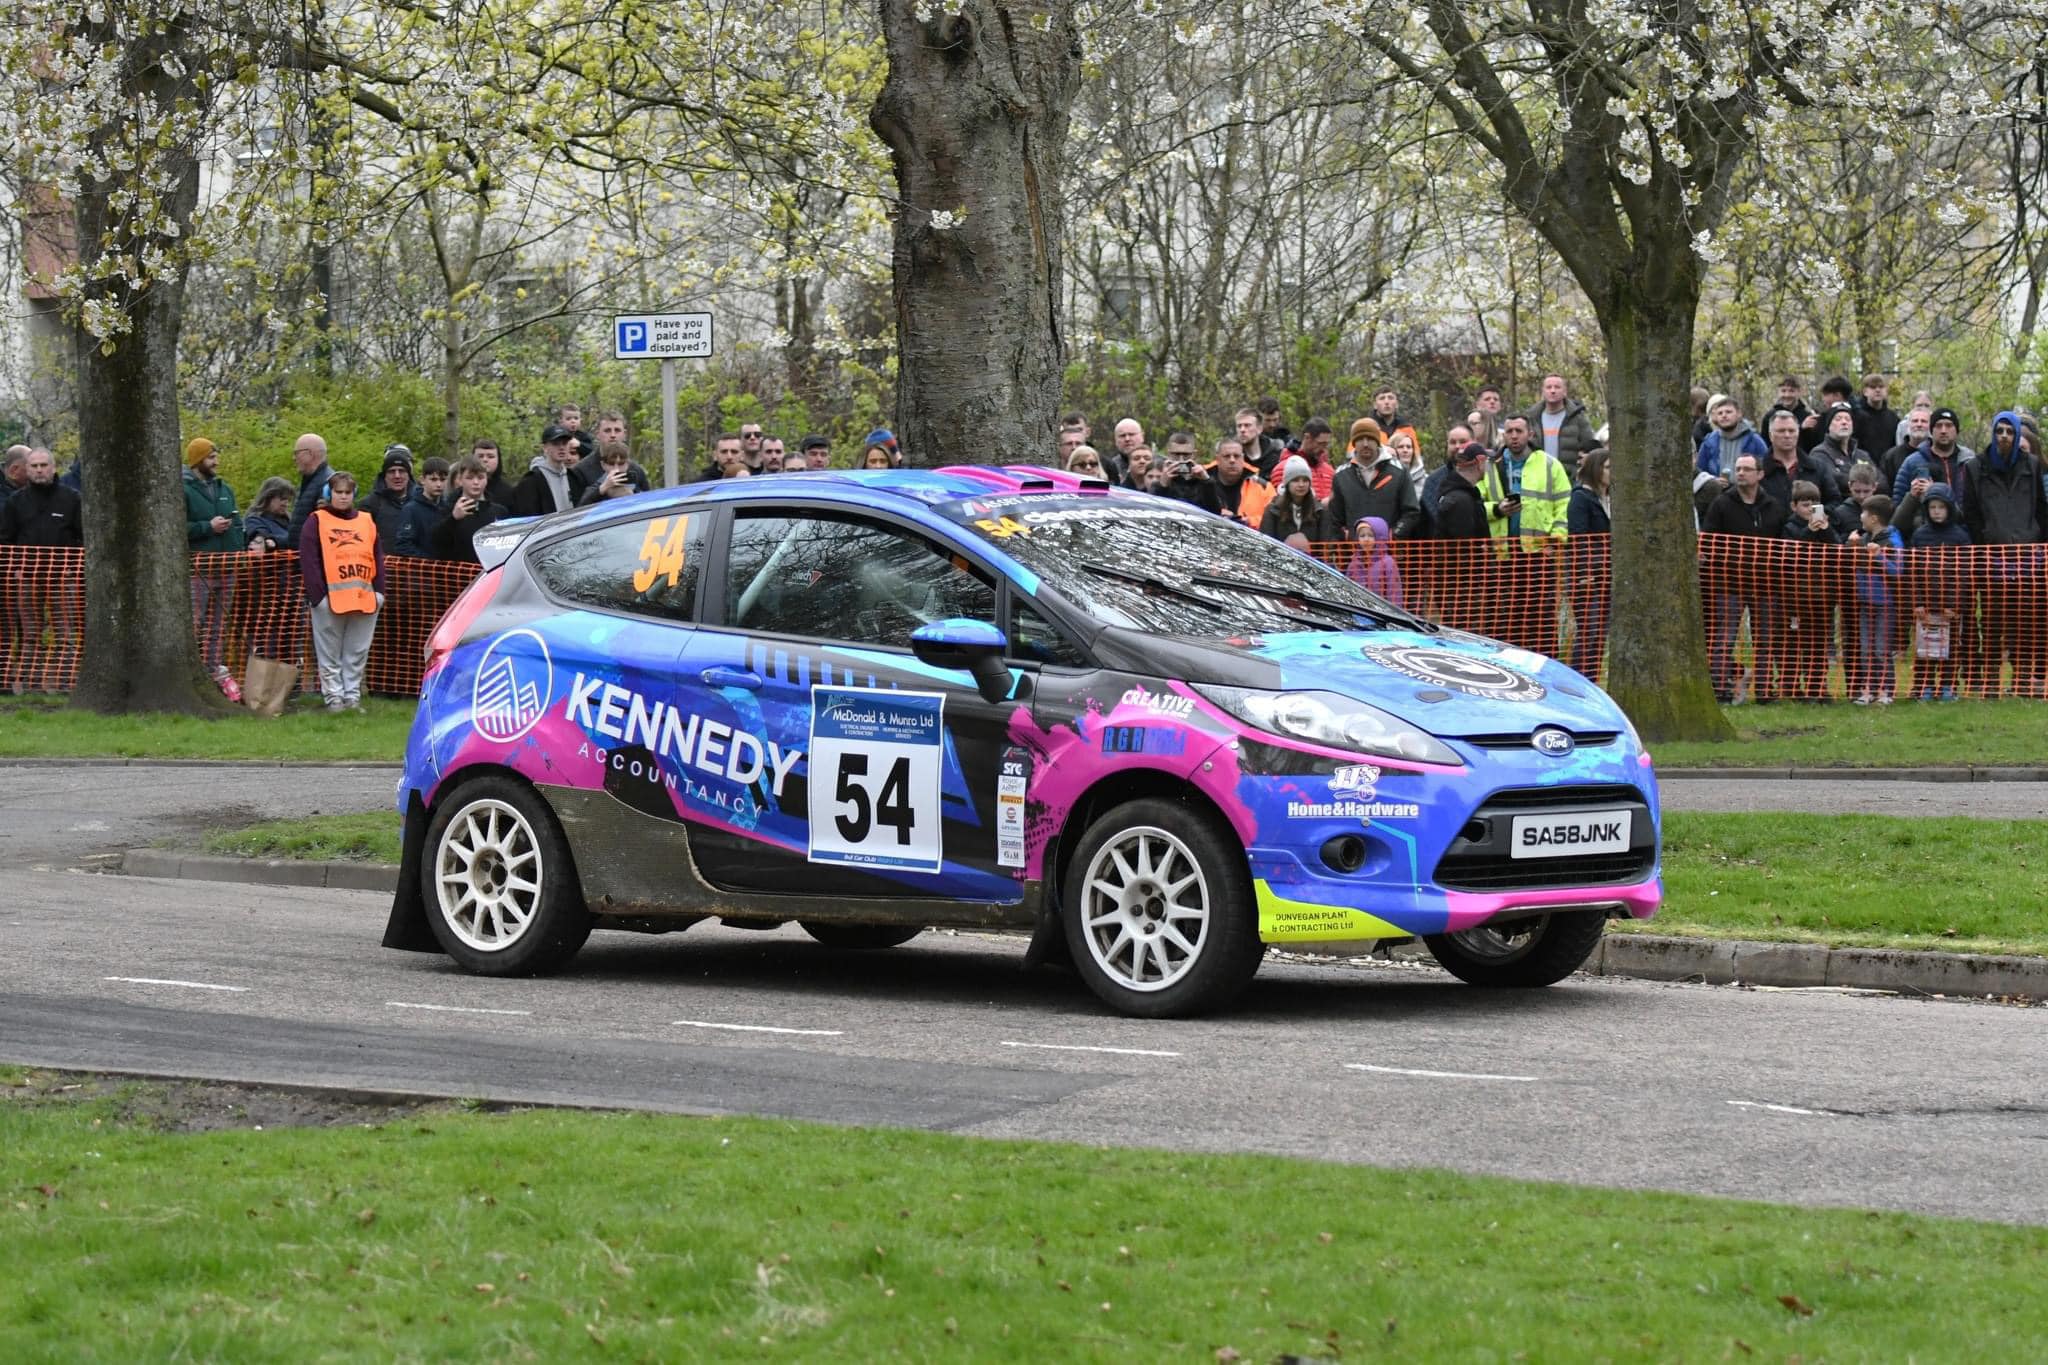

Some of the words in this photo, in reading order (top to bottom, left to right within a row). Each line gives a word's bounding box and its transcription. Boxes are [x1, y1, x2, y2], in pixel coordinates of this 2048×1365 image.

[654, 319, 681, 329] Have
[684, 320, 703, 329] you
[656, 331, 679, 341] paid
[682, 330, 701, 340] and
[625, 325, 643, 350] P
[974, 514, 1033, 538] 54
[633, 516, 689, 593] 54
[1121, 689, 1197, 713] CREATIVE
[832, 708, 876, 724] McDonald
[879, 711, 886, 724] &
[889, 712, 917, 726] Munro
[920, 713, 934, 727] Ltd
[565, 672, 802, 797] KENNEDY
[1545, 734, 1569, 749] Ford
[578, 742, 762, 819] ACCOUNTANCY
[834, 752, 915, 846] 54
[1287, 801, 1420, 817] Home&Hardware
[1522, 822, 1622, 847] SA58JNK
[1275, 912, 1320, 921] DUNVEGAN
[1321, 911, 1348, 920] PLANT
[1279, 922, 1339, 933] CONTRACTING
[1340, 921, 1354, 930] Ltd
